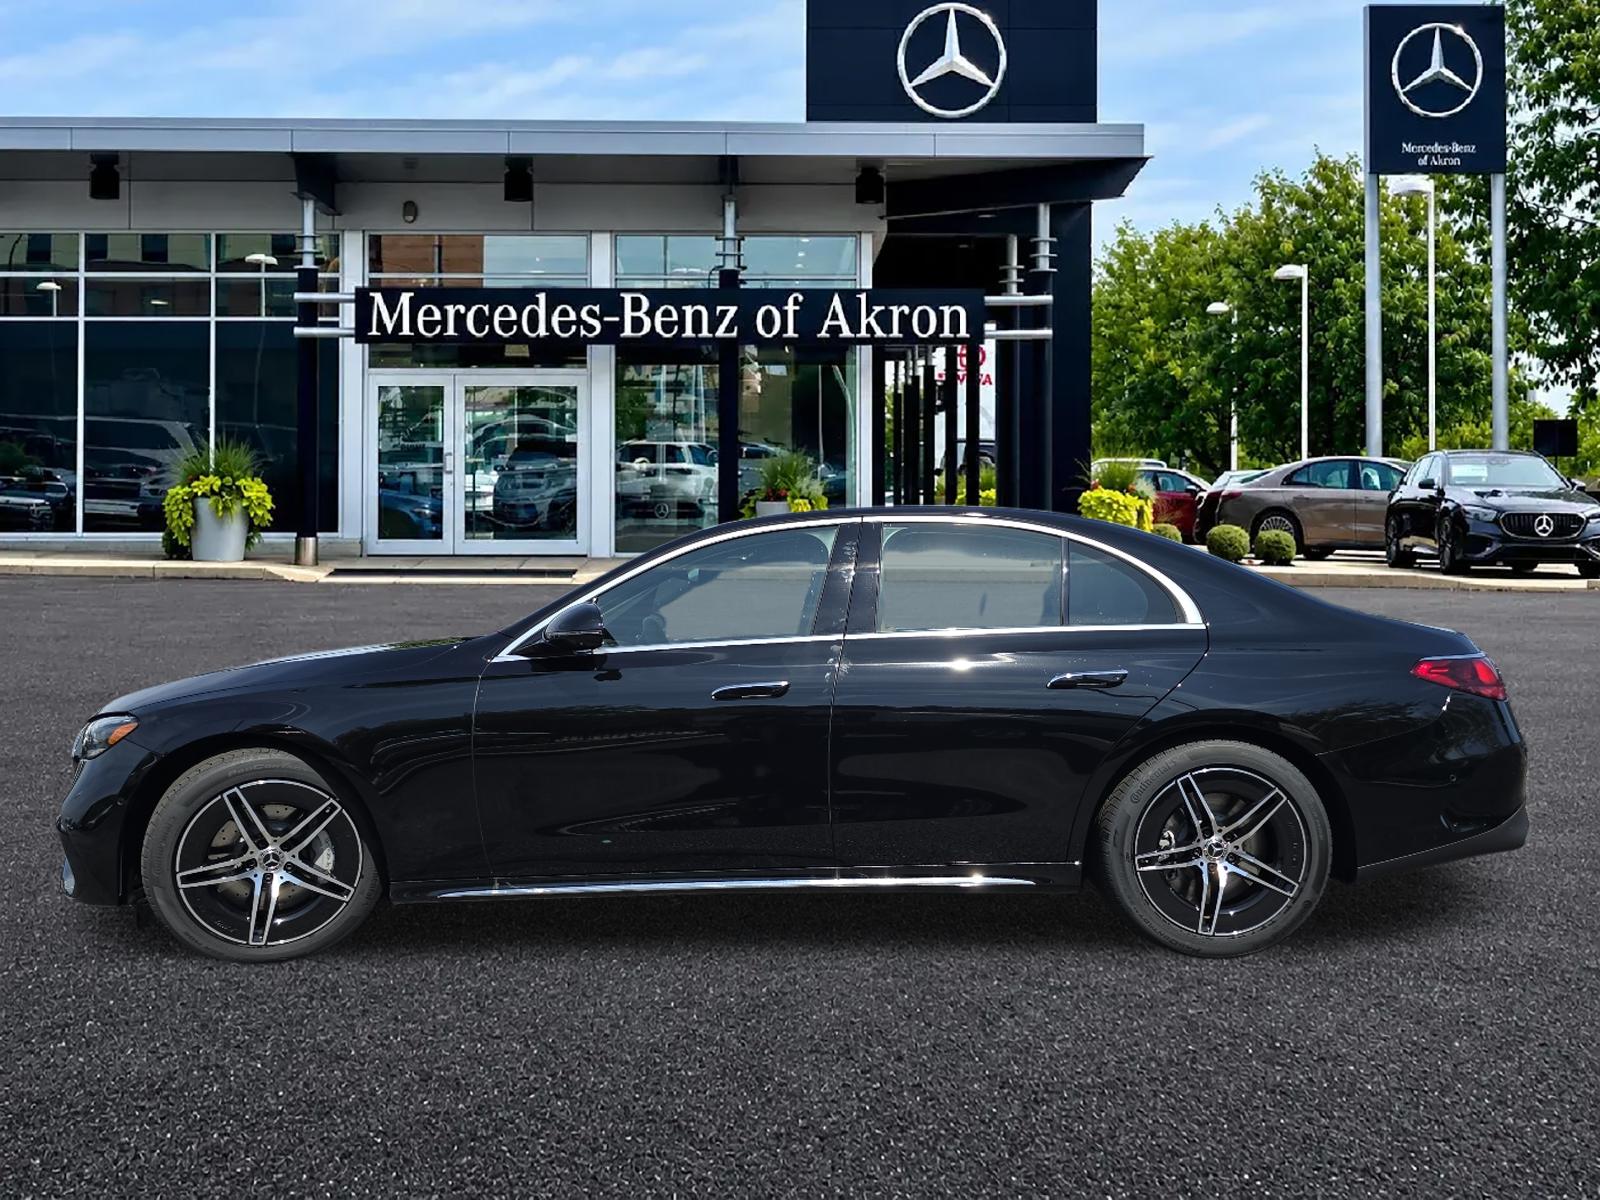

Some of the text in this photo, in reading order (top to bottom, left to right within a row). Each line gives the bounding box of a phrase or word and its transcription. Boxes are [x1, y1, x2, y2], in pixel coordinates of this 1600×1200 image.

[1401, 141, 1477, 154] Mercedes-Benz
[1417, 154, 1461, 166] of Akron
[367, 291, 971, 338] Mercedes-Benz of Akron
